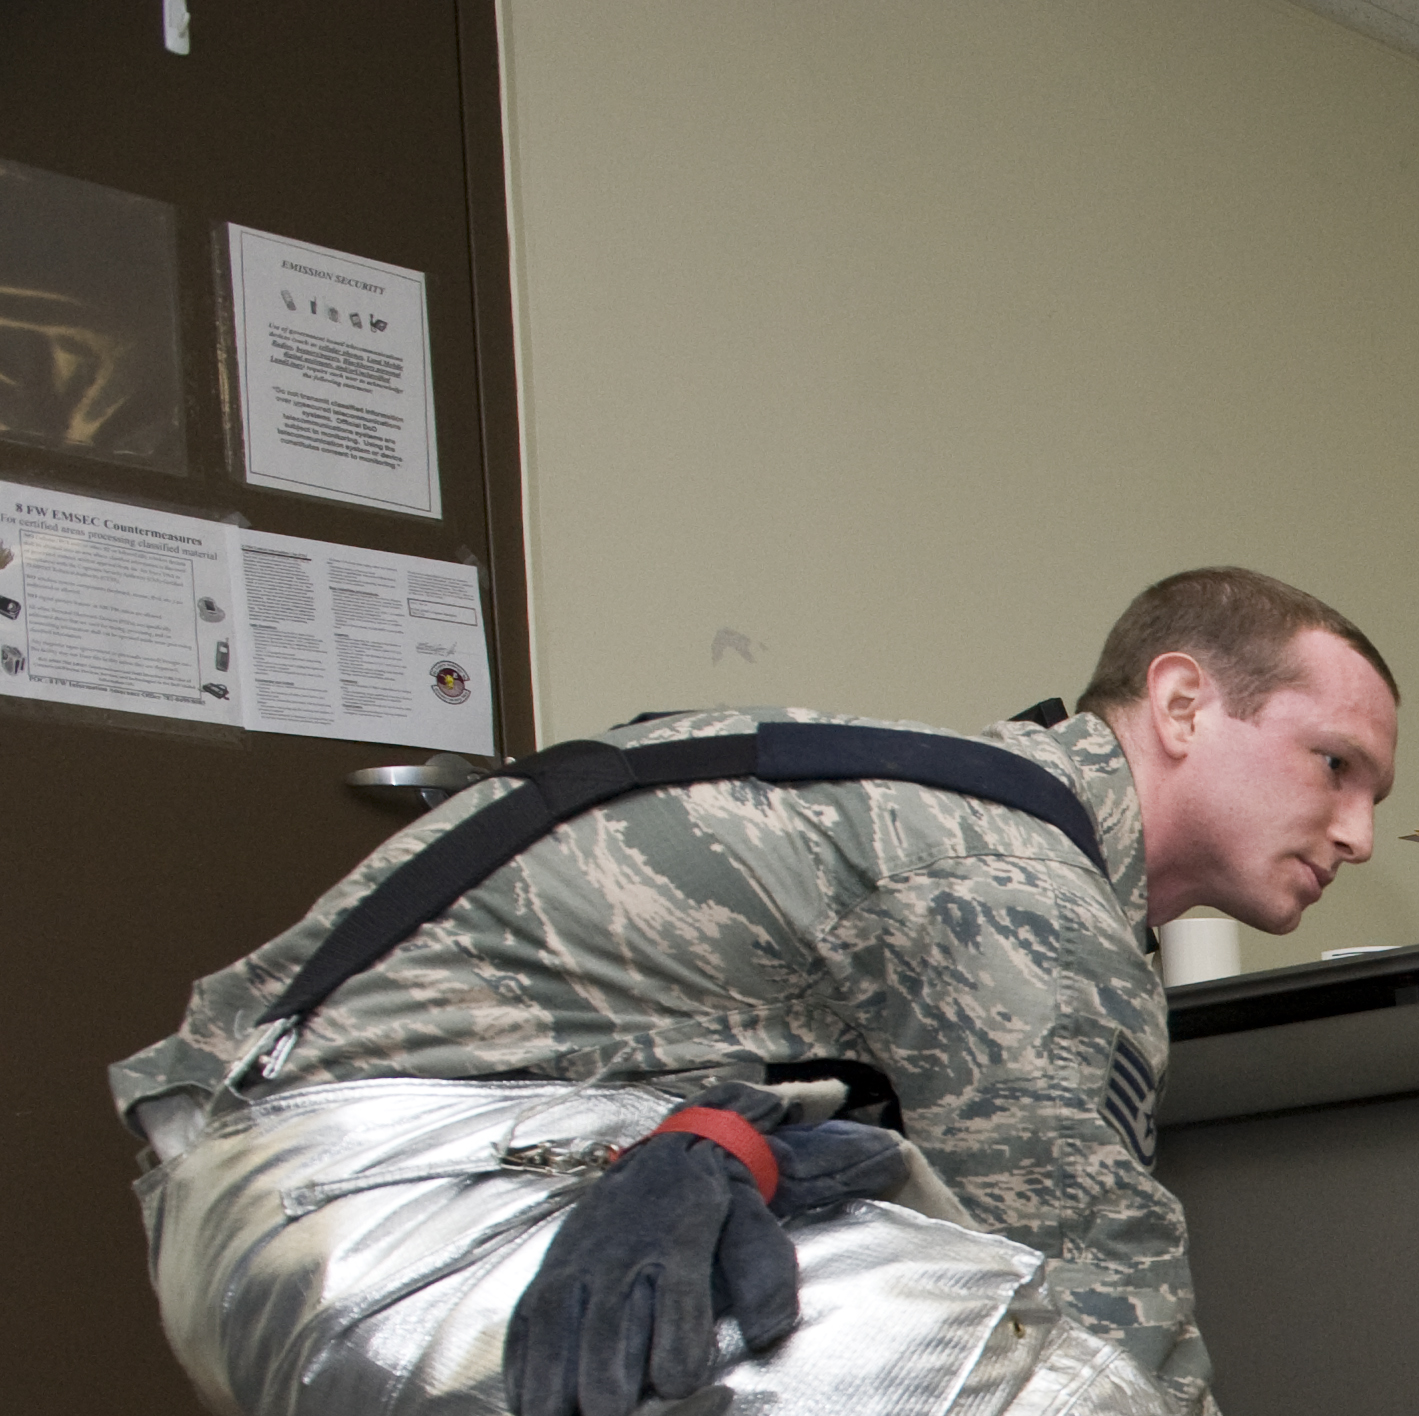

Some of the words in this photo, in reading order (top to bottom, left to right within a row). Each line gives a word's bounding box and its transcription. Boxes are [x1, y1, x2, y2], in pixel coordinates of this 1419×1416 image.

[281, 260, 333, 280] EMISSION
[334, 275, 386, 295] SECURITY
[0, 513, 16, 524] For
[18, 518, 58, 532] certified
[61, 526, 86, 536] areas
[88, 532, 136, 548] processing
[137, 539, 180, 555] classified
[182, 548, 218, 560] material
[15, 502, 23, 513] 8
[26, 504, 50, 518] FW
[52, 509, 100, 528] EMSEC
[104, 520, 202, 546] Countermeasures
